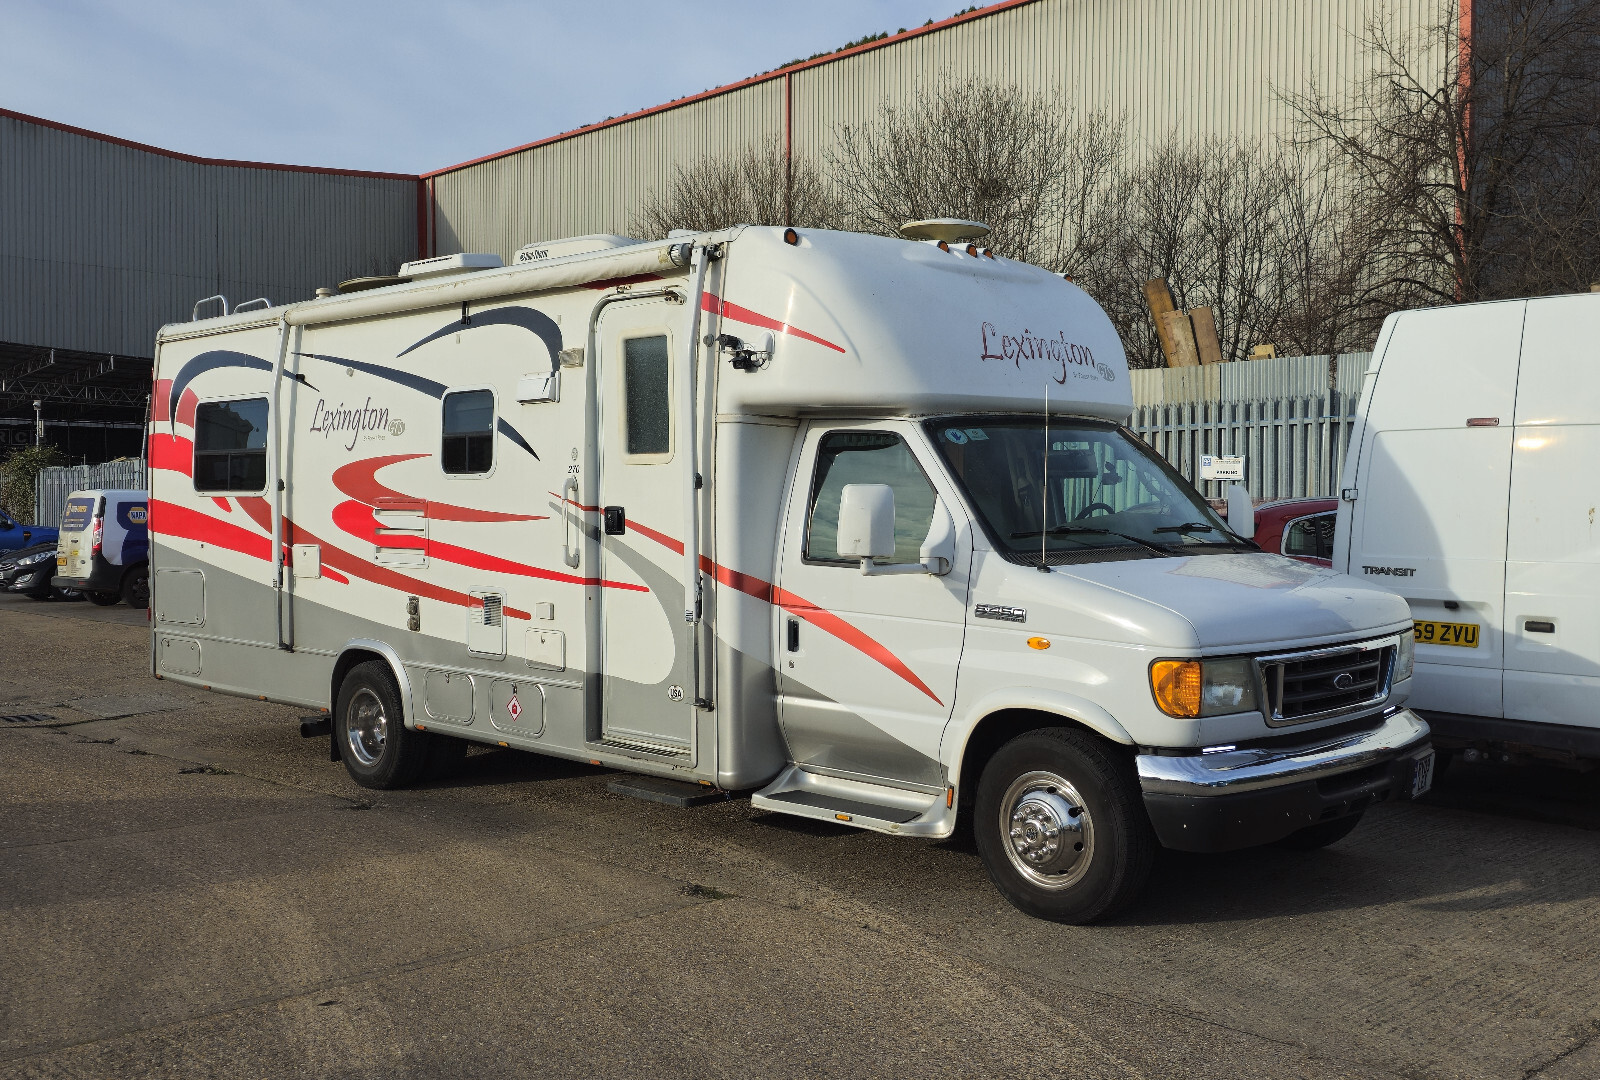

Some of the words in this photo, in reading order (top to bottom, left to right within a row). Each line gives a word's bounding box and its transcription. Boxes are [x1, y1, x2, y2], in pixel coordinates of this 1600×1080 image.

[981, 321, 1096, 385] Lexington
[309, 396, 389, 452] Lexington
[130, 510, 147, 520] NAPA
[1361, 565, 1417, 577] TRANSIT
[1440, 624, 1476, 644] ZVU
[670, 688, 682, 698] USA
